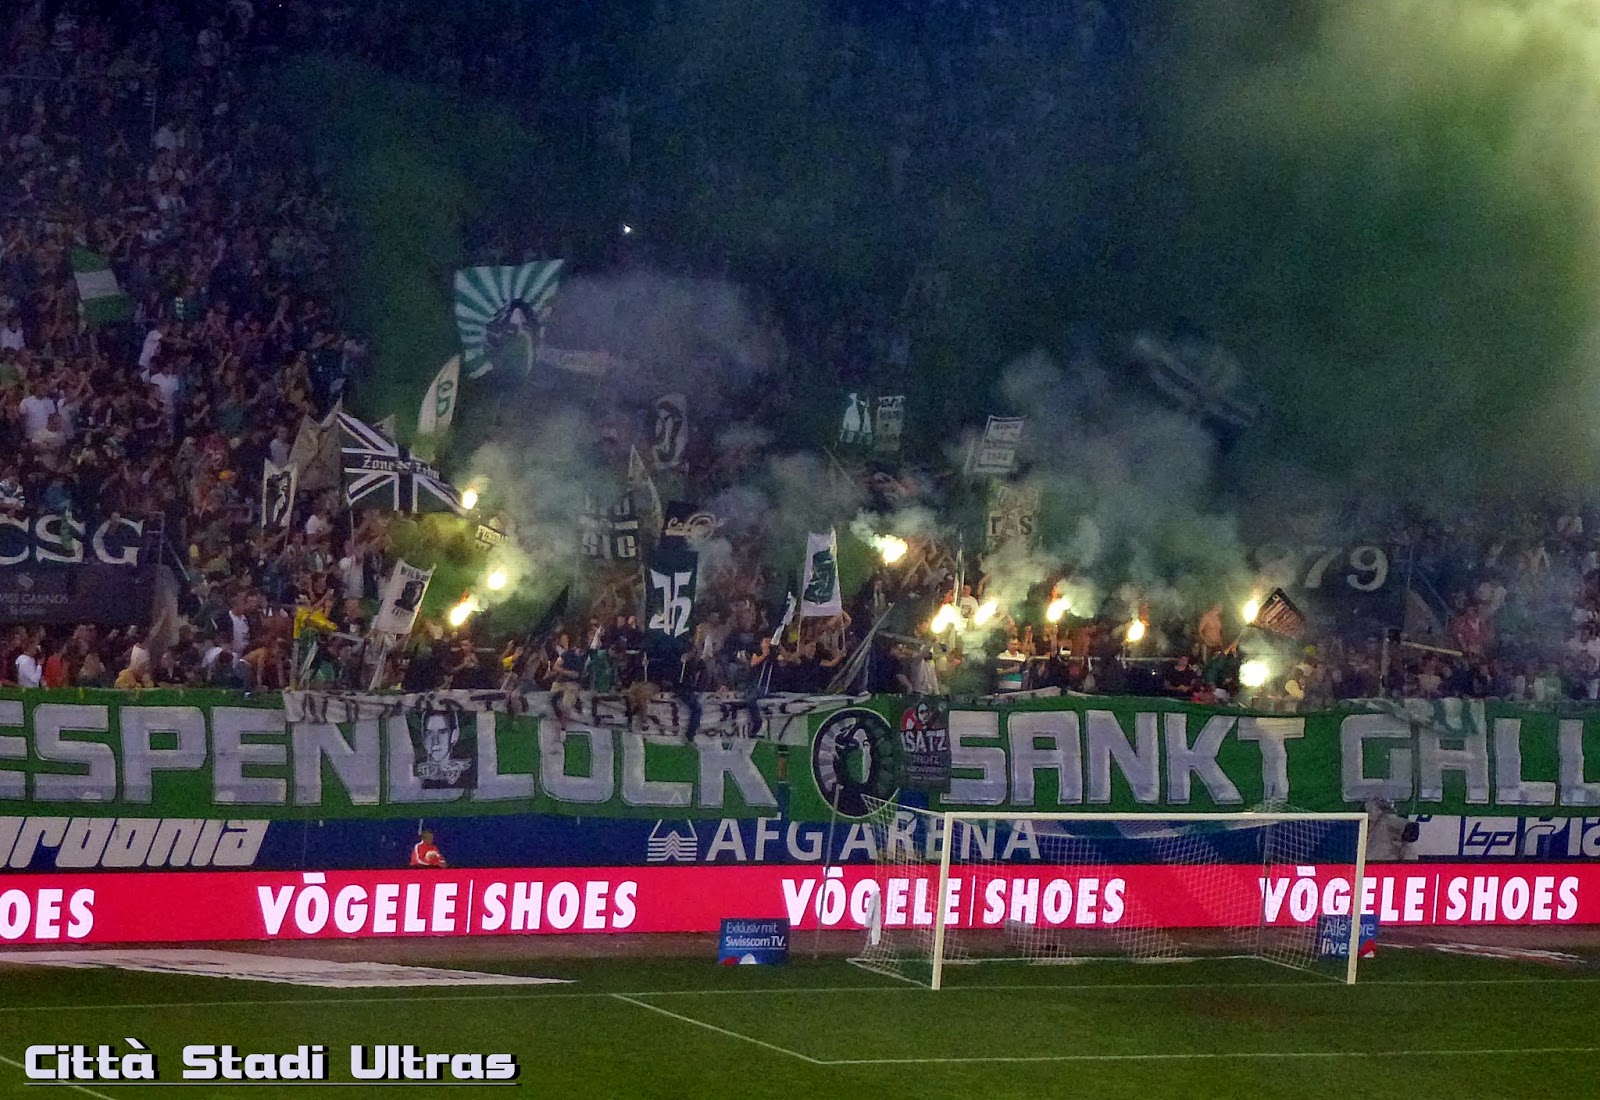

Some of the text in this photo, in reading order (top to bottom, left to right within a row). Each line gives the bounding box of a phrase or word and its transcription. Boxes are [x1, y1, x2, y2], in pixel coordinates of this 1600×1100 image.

[362, 454, 395, 471] Zone
[942, 708, 1306, 806] SANKT
[705, 812, 1041, 862] AFG ARENA
[1465, 821, 1517, 856] bp
[481, 881, 637, 931] SHOES
[983, 878, 1126, 924] SHOES
[1446, 876, 1580, 921] SHOES
[725, 936, 770, 947] Swisscom
[726, 921, 778, 934] Exklusiv mit
[1323, 919, 1347, 936] Alle
